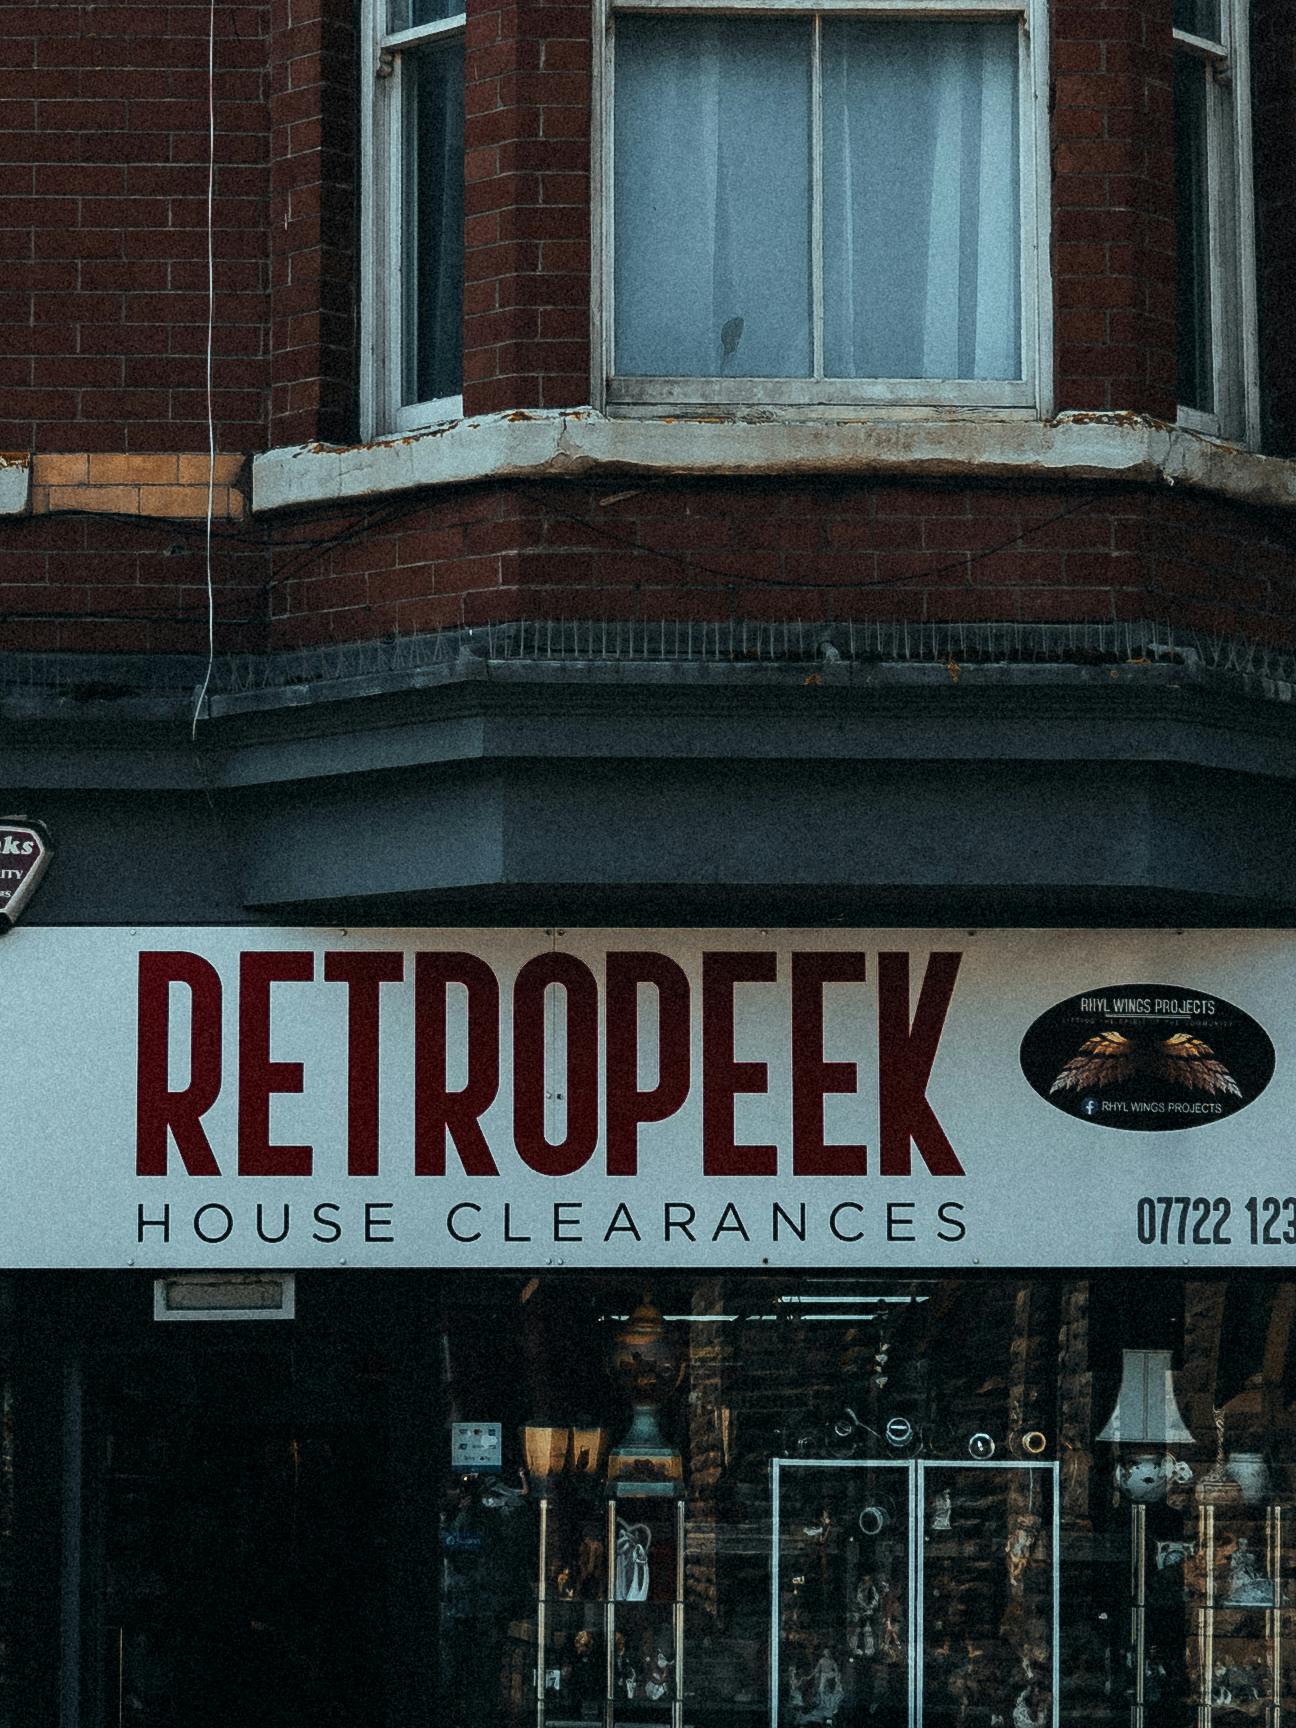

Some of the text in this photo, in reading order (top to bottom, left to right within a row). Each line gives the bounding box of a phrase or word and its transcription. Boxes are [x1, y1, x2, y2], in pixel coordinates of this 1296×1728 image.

[1080, 997, 1216, 1016] RHYL WINGS PROJECTS
[136, 948, 966, 1177] RETROPEEK
[1101, 1101, 1129, 1113] RHYL
[1131, 1101, 1165, 1113] WINGS
[1168, 1102, 1222, 1114] PROJECTS
[137, 1201, 966, 1244] HOUSE CLEARANCES
[1137, 1196, 1232, 1245] 07722
